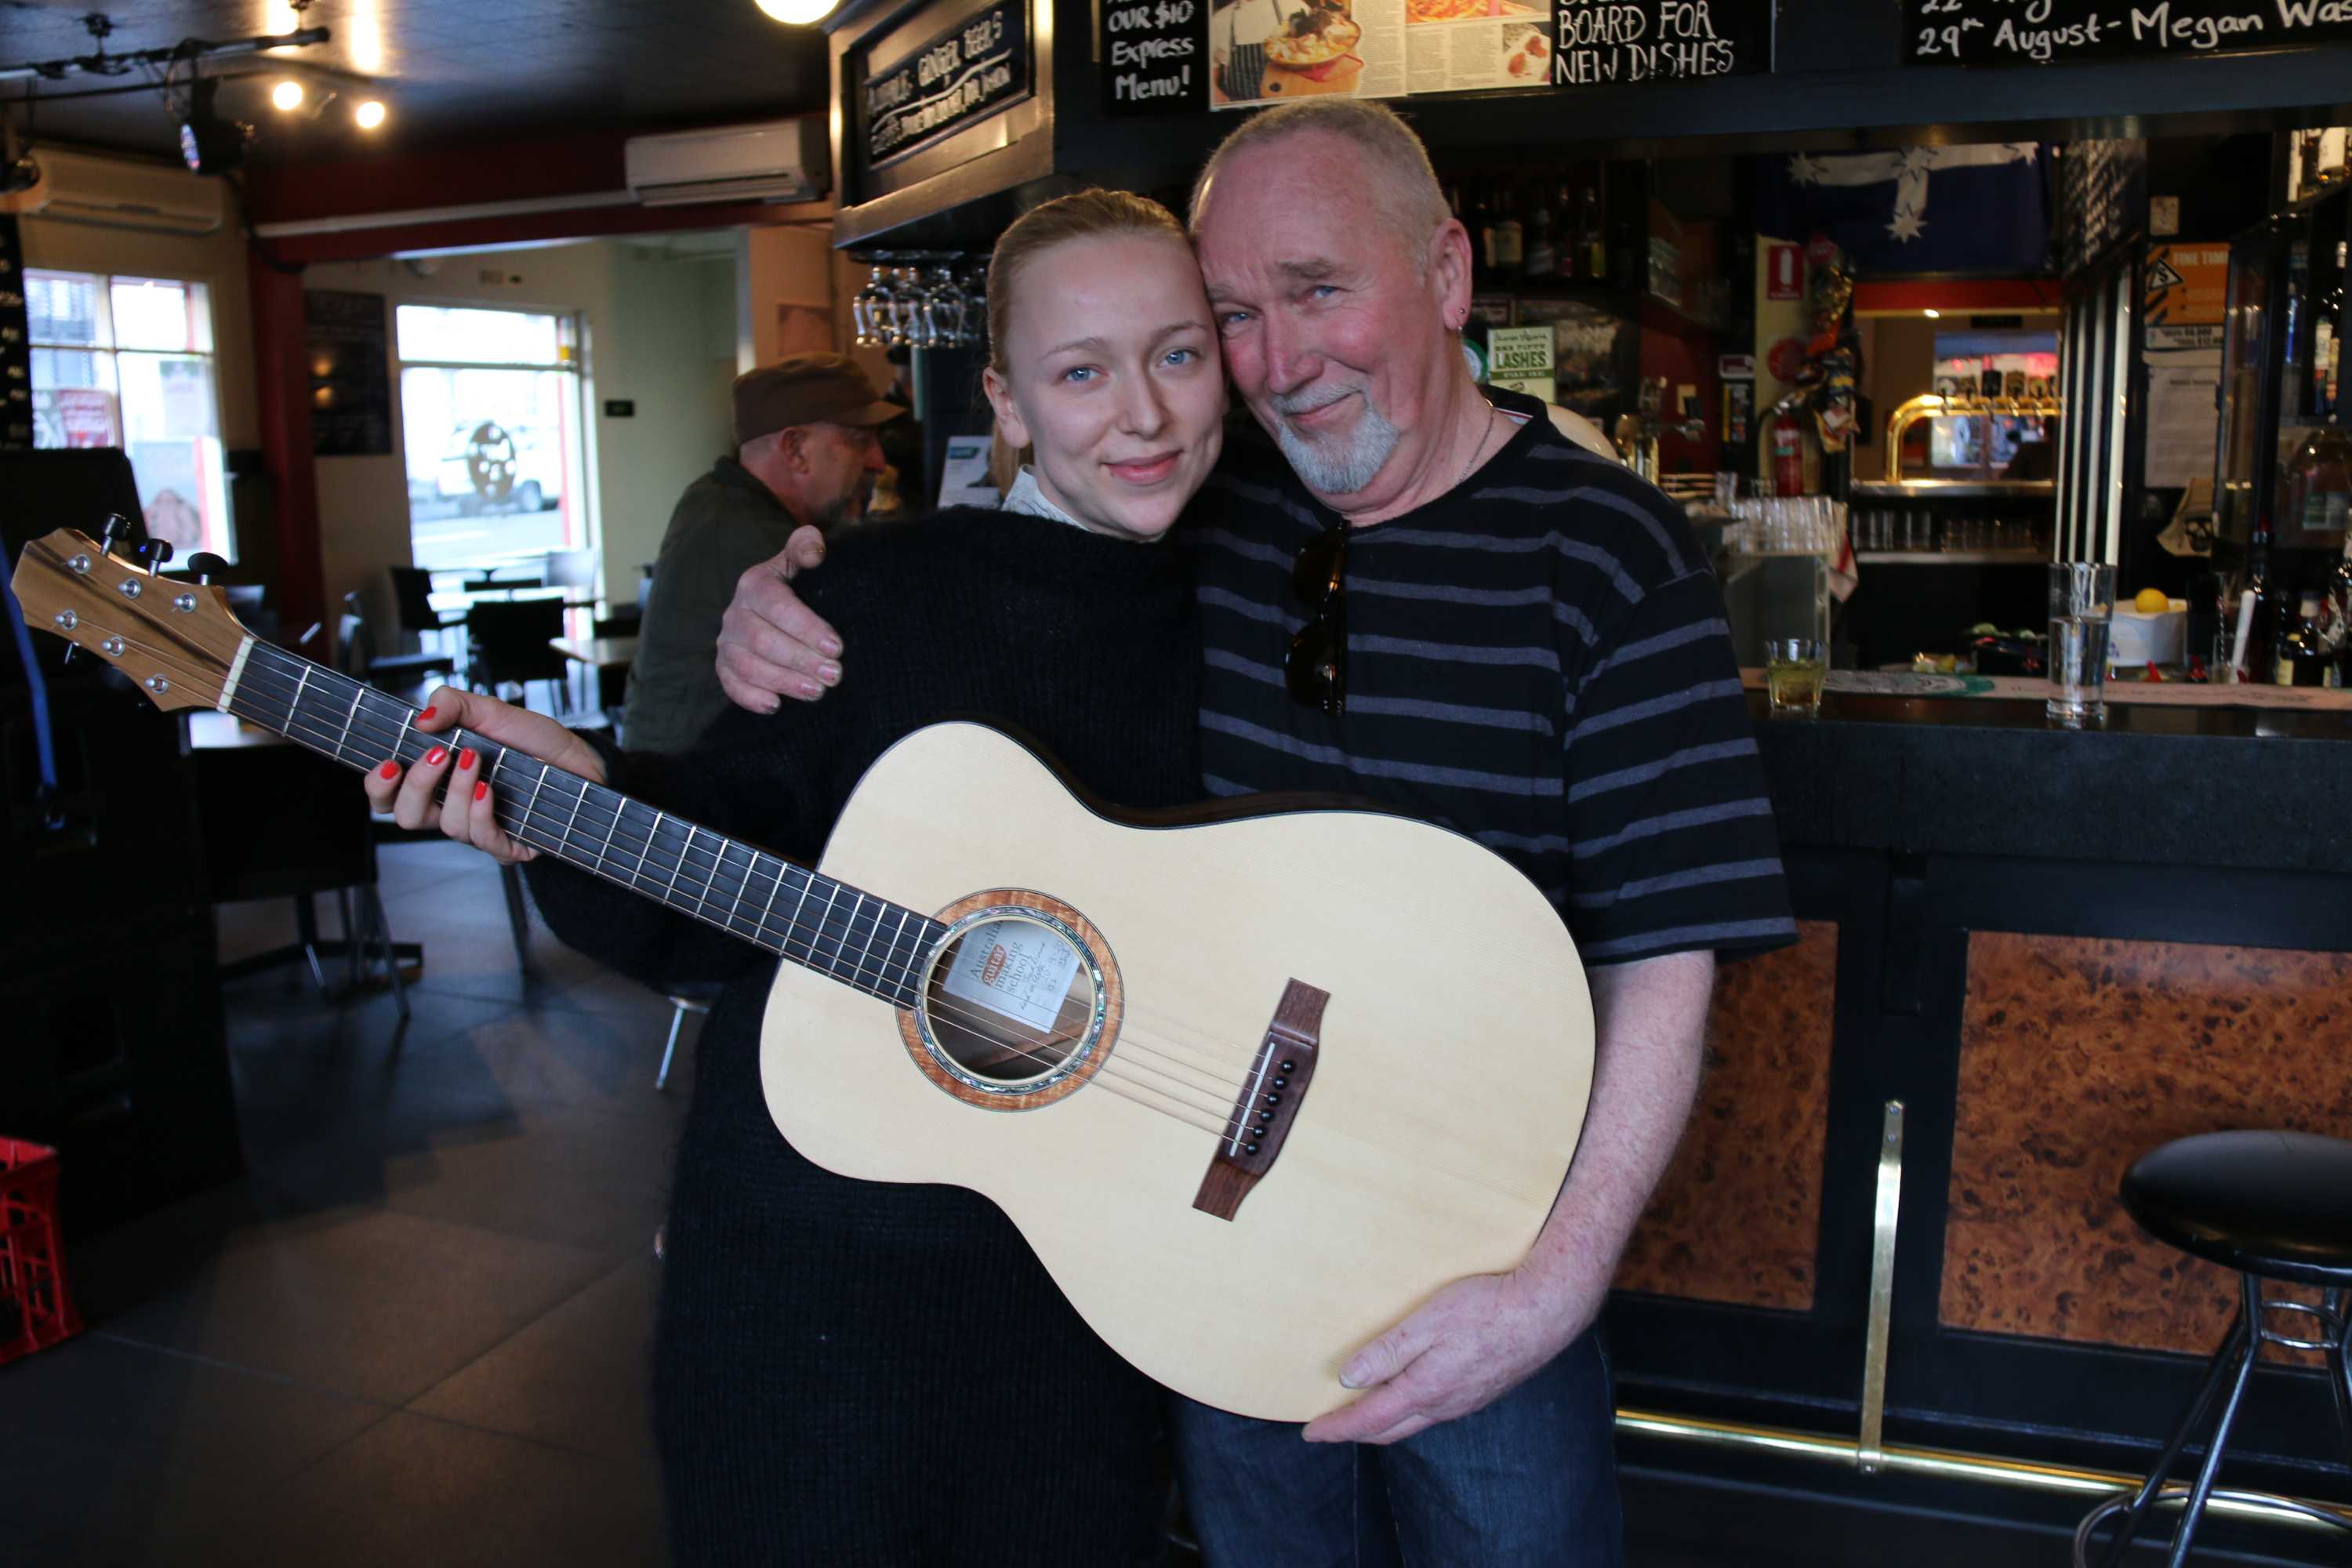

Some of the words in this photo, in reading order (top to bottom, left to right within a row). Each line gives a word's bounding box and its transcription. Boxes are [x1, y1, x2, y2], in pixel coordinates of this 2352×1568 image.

[1108, 5, 1152, 32] OUR
[1154, 0, 1195, 30] $10
[1558, 5, 1647, 49] BOARD
[1657, 0, 1718, 40] FOR
[2131, 1, 2264, 49] Megan
[1111, 38, 1195, 69] Express
[1555, 47, 1619, 85] NEW
[1624, 39, 1734, 82] DISHES
[1115, 64, 1190, 101] Menu!
[1495, 350, 1548, 369] LASHES
[982, 946, 1004, 985] guitar
[996, 941, 1023, 989] making
[1007, 953, 1029, 993] school
